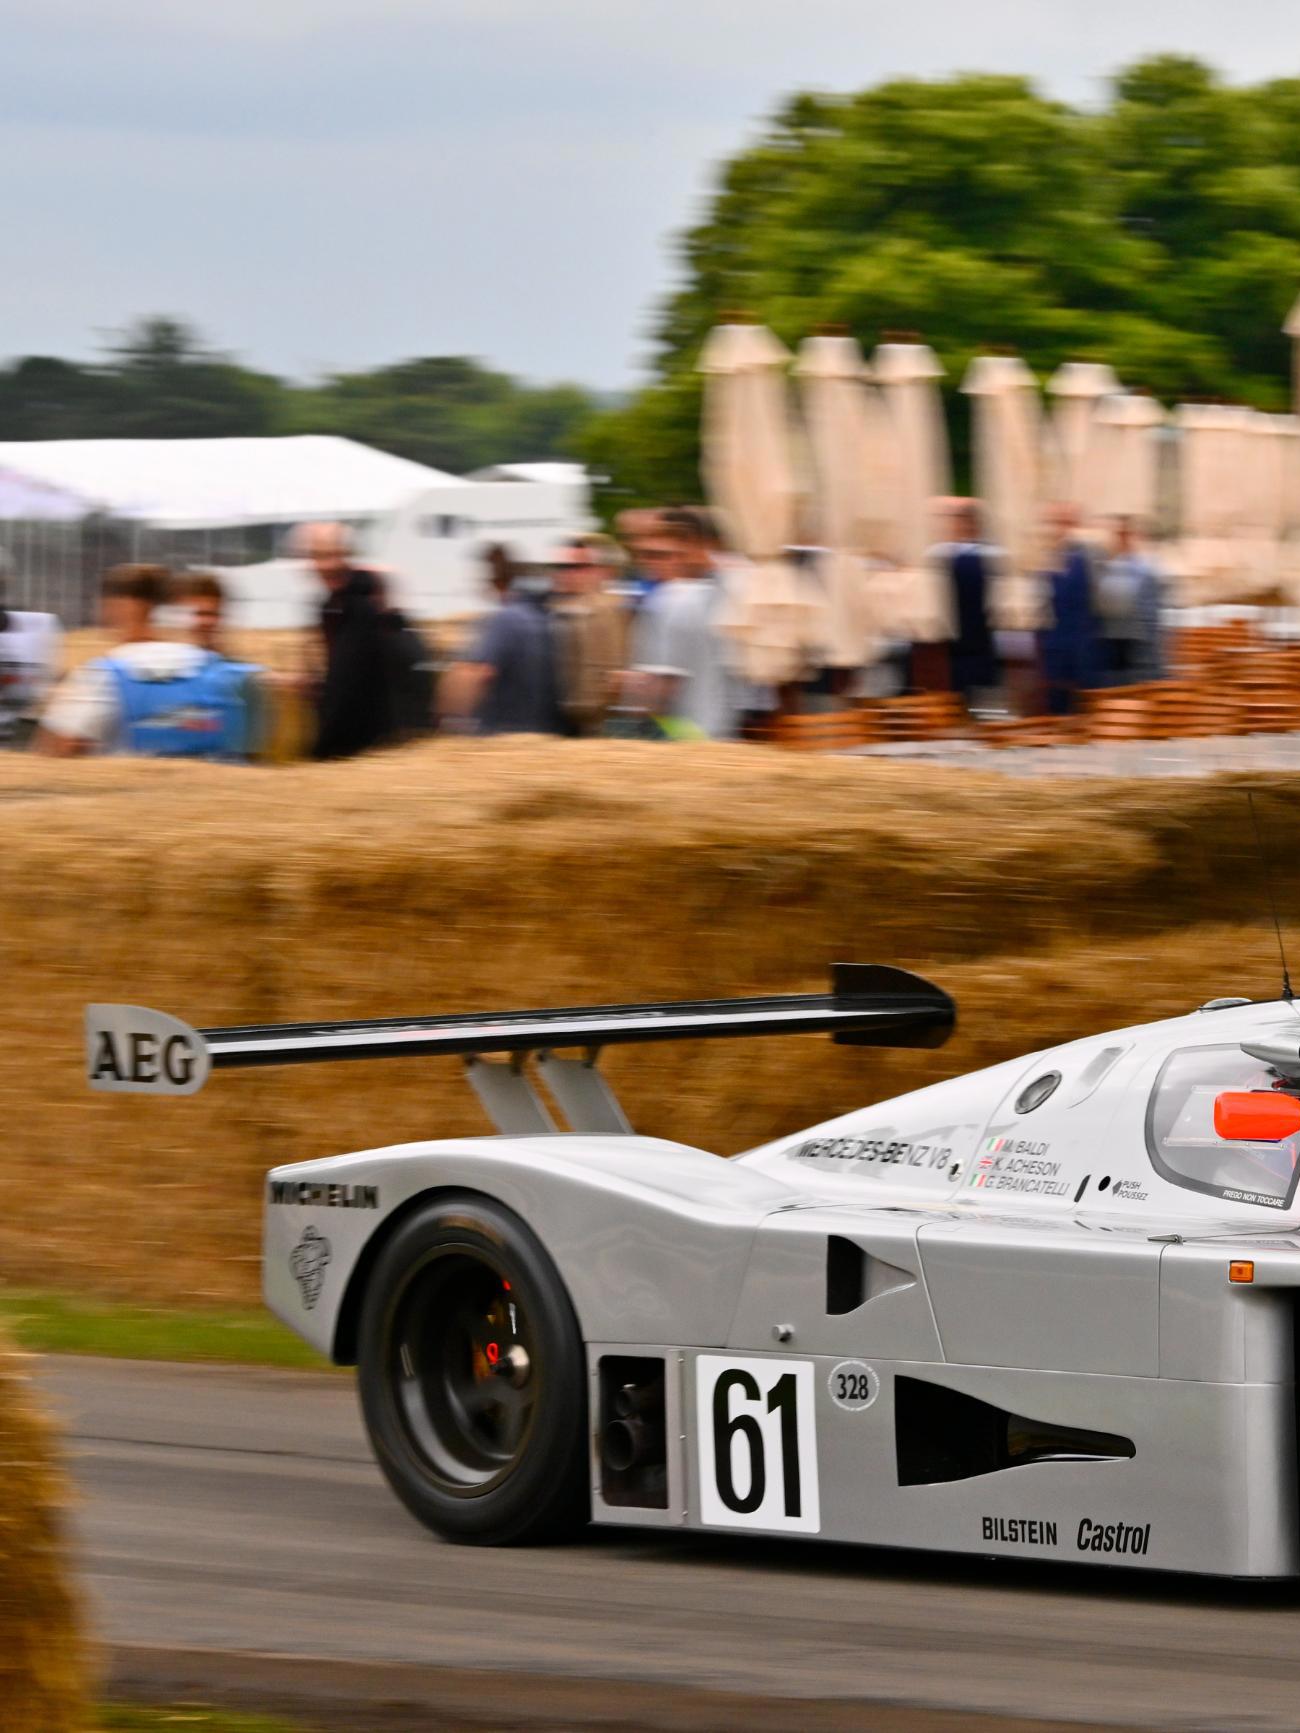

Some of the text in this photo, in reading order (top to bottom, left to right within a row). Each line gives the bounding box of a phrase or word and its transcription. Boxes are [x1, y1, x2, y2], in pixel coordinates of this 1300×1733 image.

[89, 1030, 197, 1086] AEG
[1015, 1140, 1050, 1157] BALDI
[1005, 1159, 1061, 1177] ACHESON
[270, 1181, 380, 1209] MICHELIN
[995, 1177, 1072, 1197] BRANCATELLI
[837, 1373, 869, 1400] 328
[713, 1368, 801, 1517] 61
[982, 1516, 1058, 1546] BILSTEIN
[1077, 1517, 1152, 1555] Castrol
